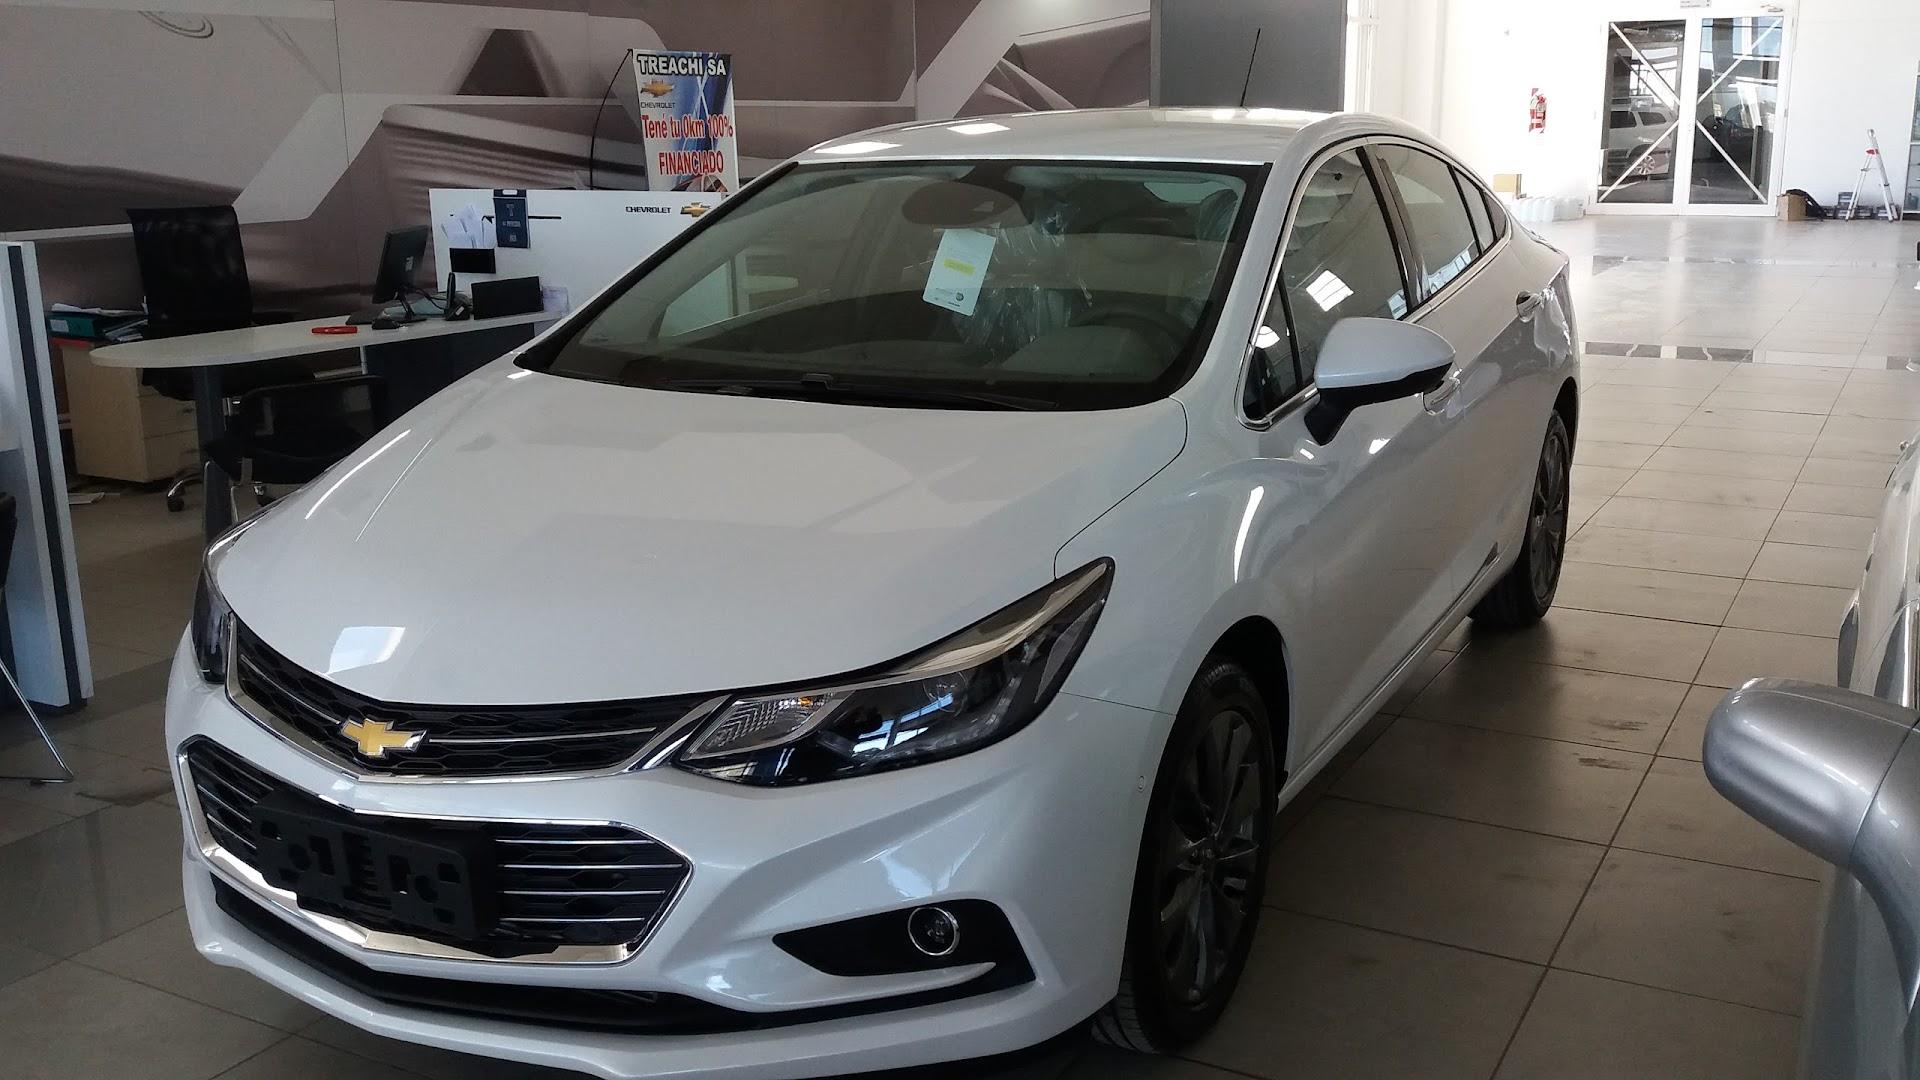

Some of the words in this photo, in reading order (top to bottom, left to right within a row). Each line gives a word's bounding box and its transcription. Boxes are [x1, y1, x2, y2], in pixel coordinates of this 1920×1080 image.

[637, 54, 704, 76] TREACHI
[706, 58, 727, 76] SA
[640, 101, 676, 109] CHEVROLET
[640, 114, 668, 139] Tené
[669, 119, 681, 138] tu
[707, 114, 734, 138] 100%
[659, 150, 725, 175] FINANCIADO
[625, 206, 672, 214] CHEVROLET
